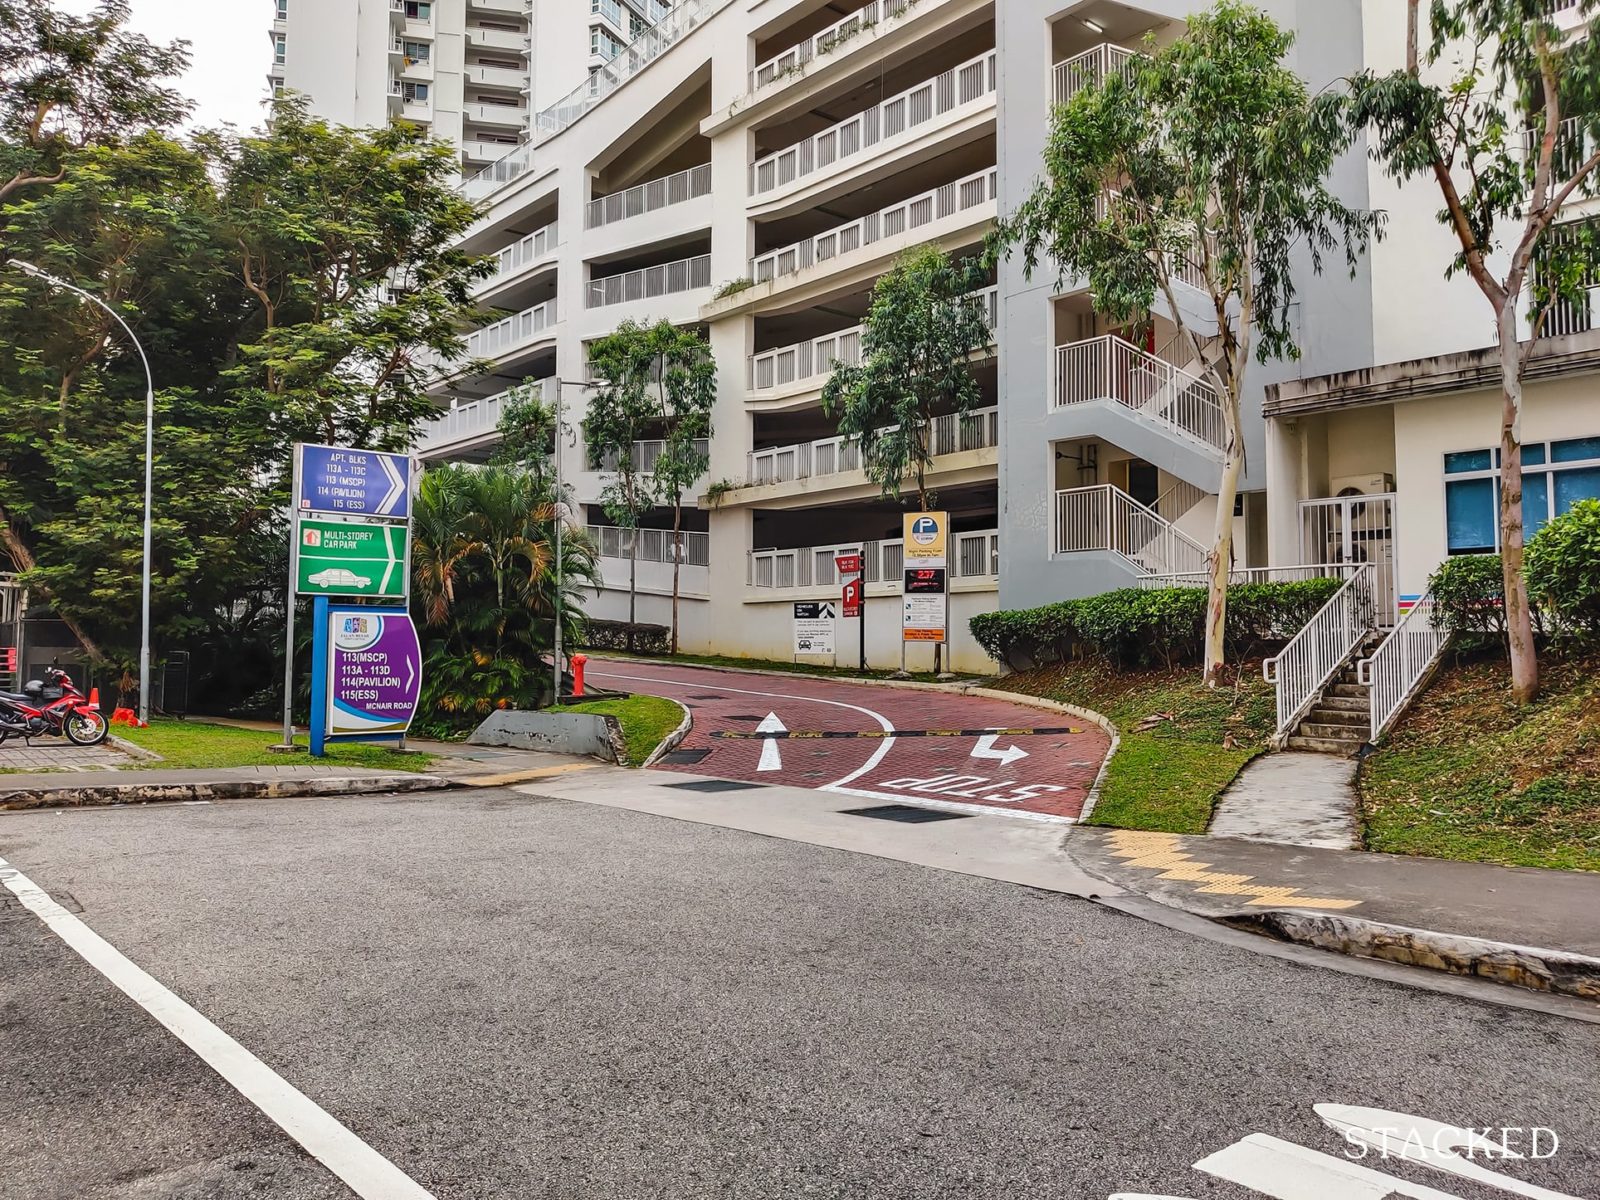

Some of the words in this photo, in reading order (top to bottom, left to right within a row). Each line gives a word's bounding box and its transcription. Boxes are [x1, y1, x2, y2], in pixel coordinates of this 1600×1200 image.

[331, 453, 346, 463] APT.
[349, 455, 366, 465] BLKS
[327, 464, 342, 473] 113A
[351, 466, 366, 476] 113C
[326, 475, 336, 485] 113
[340, 477, 366, 487] (MSCP)
[318, 486, 329, 496] 114
[332, 487, 366, 498] (PAVILION)
[333, 499, 344, 508] 115
[347, 500, 365, 510] (ESS)
[920, 518, 933, 533] P
[324, 530, 374, 541] MULTI-STOREY
[846, 586, 855, 603] P
[342, 652, 388, 665] 113(MSCP)
[341, 665, 363, 675] 113A
[370, 665, 391, 675] 113D
[341, 676, 401, 689] 114(PAVILION)
[340, 689, 379, 702] 115(ESS)
[366, 702, 393, 710] MCNAIR
[393, 702, 413, 710] ROAD
[877, 774, 1068, 803] STOP
